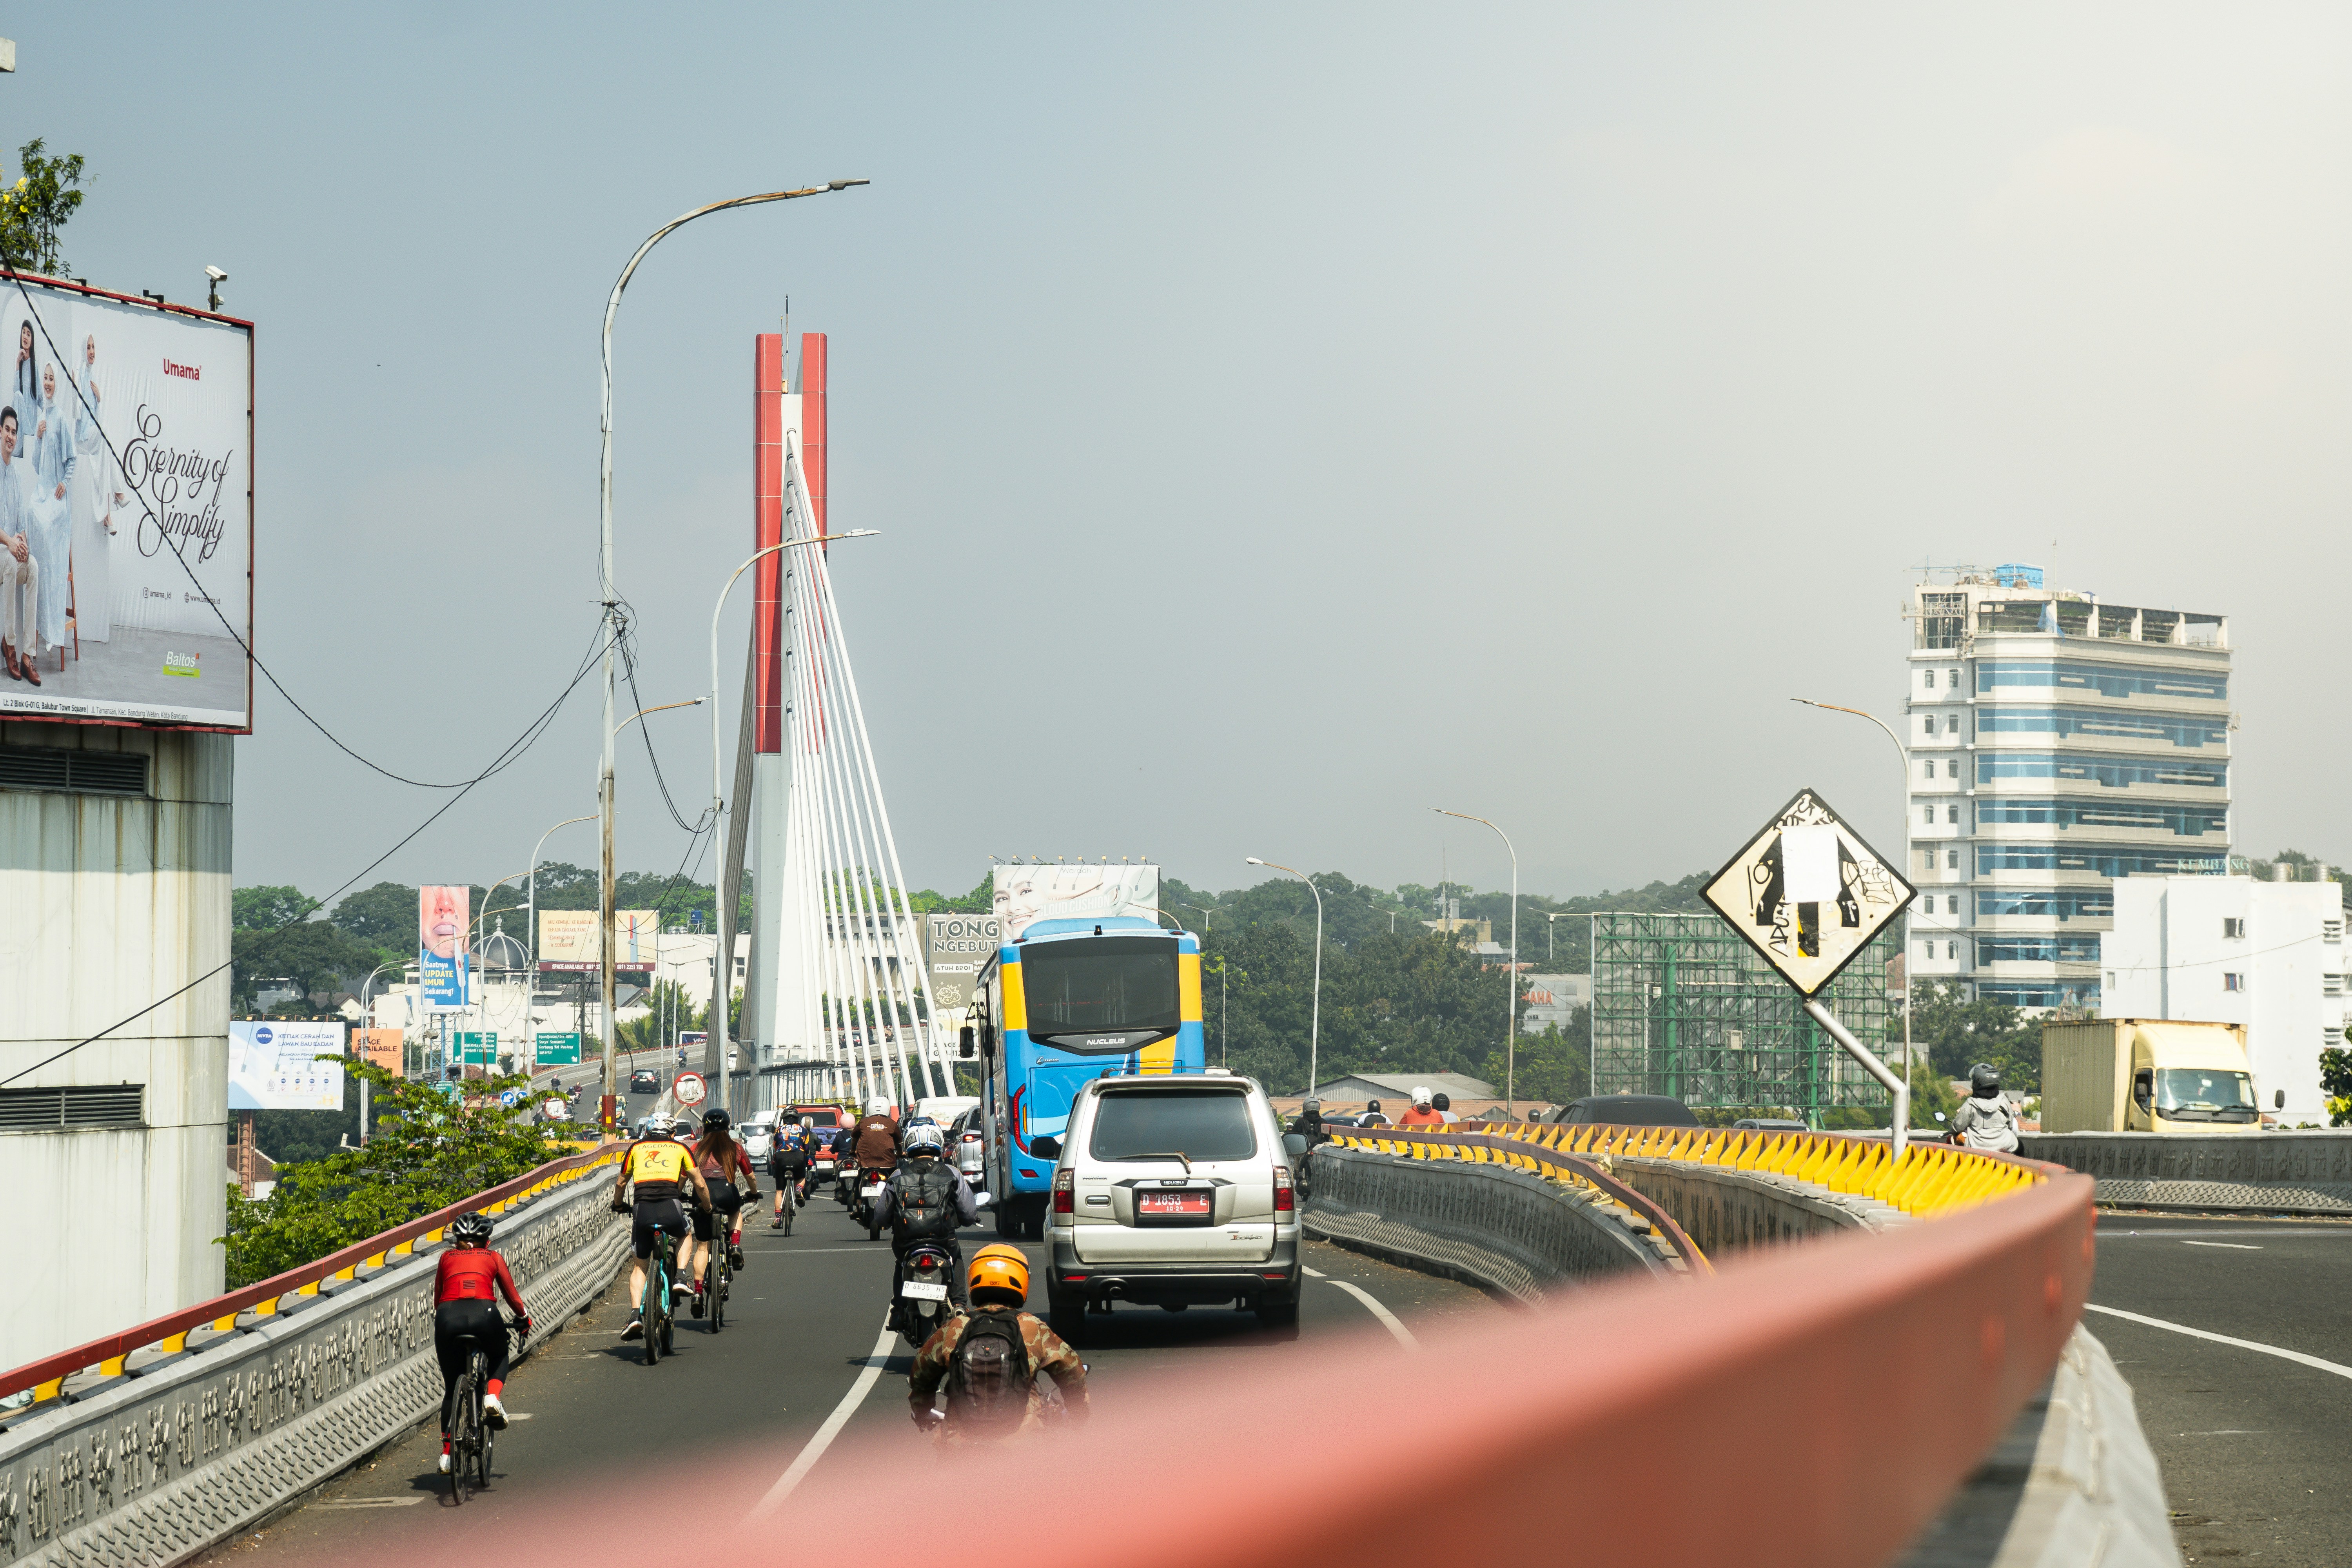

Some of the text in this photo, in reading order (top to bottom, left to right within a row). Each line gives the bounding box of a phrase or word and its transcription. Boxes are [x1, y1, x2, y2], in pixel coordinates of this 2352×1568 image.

[163, 358, 200, 381] Umama
[123, 404, 234, 507] Eternity of
[137, 467, 225, 563] Simplify
[149, 591, 171, 600] umama_id
[166, 651, 195, 667] Baltos
[59, 703, 70, 711] Town
[71, 704, 86, 713] Square
[128, 709, 145, 718] Bandung
[171, 712, 188, 721] Bandung
[1038, 895, 1111, 917] CLOUD CUSHION
[932, 919, 999, 938] TONG
[933, 940, 999, 953] NGEBUT
[425, 961, 448, 969] Saatnya
[425, 987, 454, 996] Sekarang!
[1142, 1194, 1207, 1206] D 1853 E
